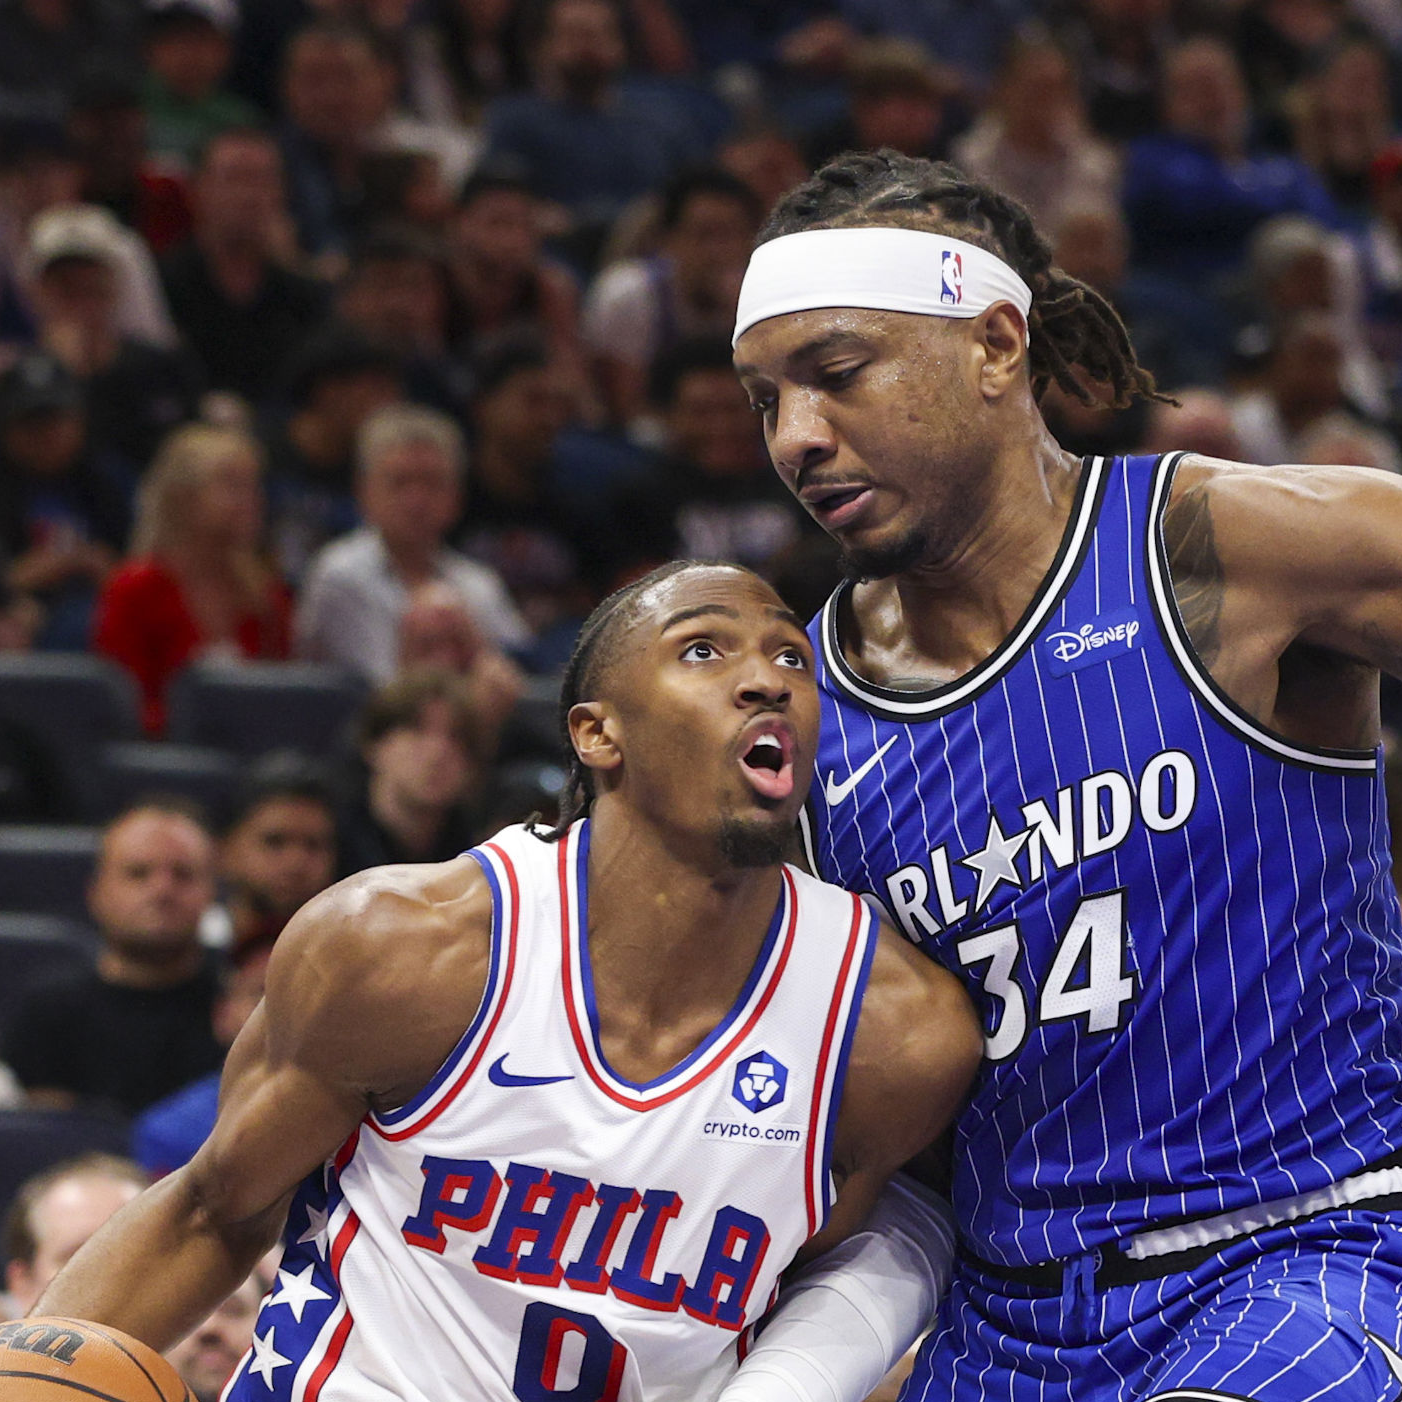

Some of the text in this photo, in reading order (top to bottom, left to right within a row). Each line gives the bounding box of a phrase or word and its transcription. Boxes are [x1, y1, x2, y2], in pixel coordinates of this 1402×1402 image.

[1045, 621, 1139, 662] Disney
[956, 887, 1139, 1061] 34
[703, 1122, 801, 1141] crypto.com
[400, 1155, 771, 1332] PHILA
